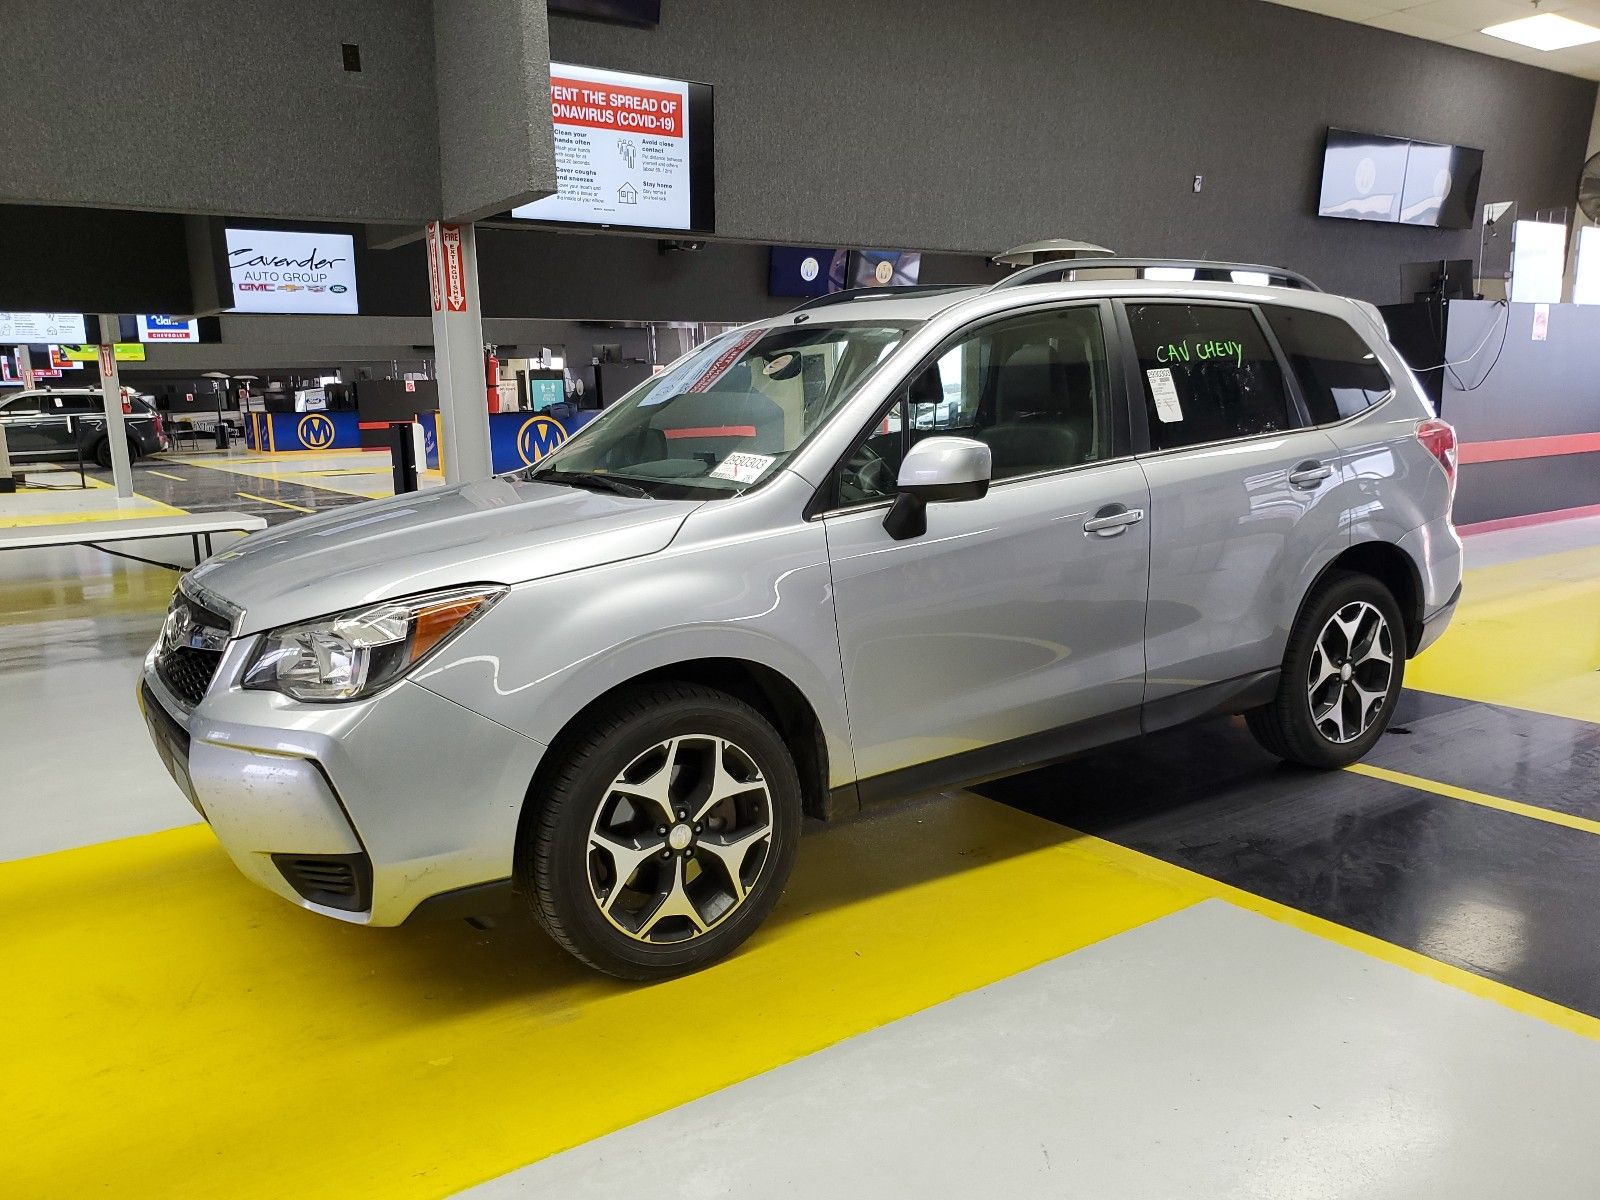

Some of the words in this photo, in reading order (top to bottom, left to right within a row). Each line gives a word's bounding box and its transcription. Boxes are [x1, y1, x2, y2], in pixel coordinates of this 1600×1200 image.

[582, 90, 606, 105] THE
[610, 94, 658, 112] SPREAD
[660, 100, 676, 114] OF
[617, 110, 674, 132] (COVID-19)
[444, 232, 458, 242] FIRE
[228, 248, 346, 271] Cavender
[244, 271, 280, 282] AUTO
[283, 272, 328, 282] GROUP
[450, 244, 460, 306] EXTINGUISHER
[239, 283, 276, 292] GMC
[1156, 340, 1190, 363] CAV
[1196, 341, 1242, 368] CHEVY
